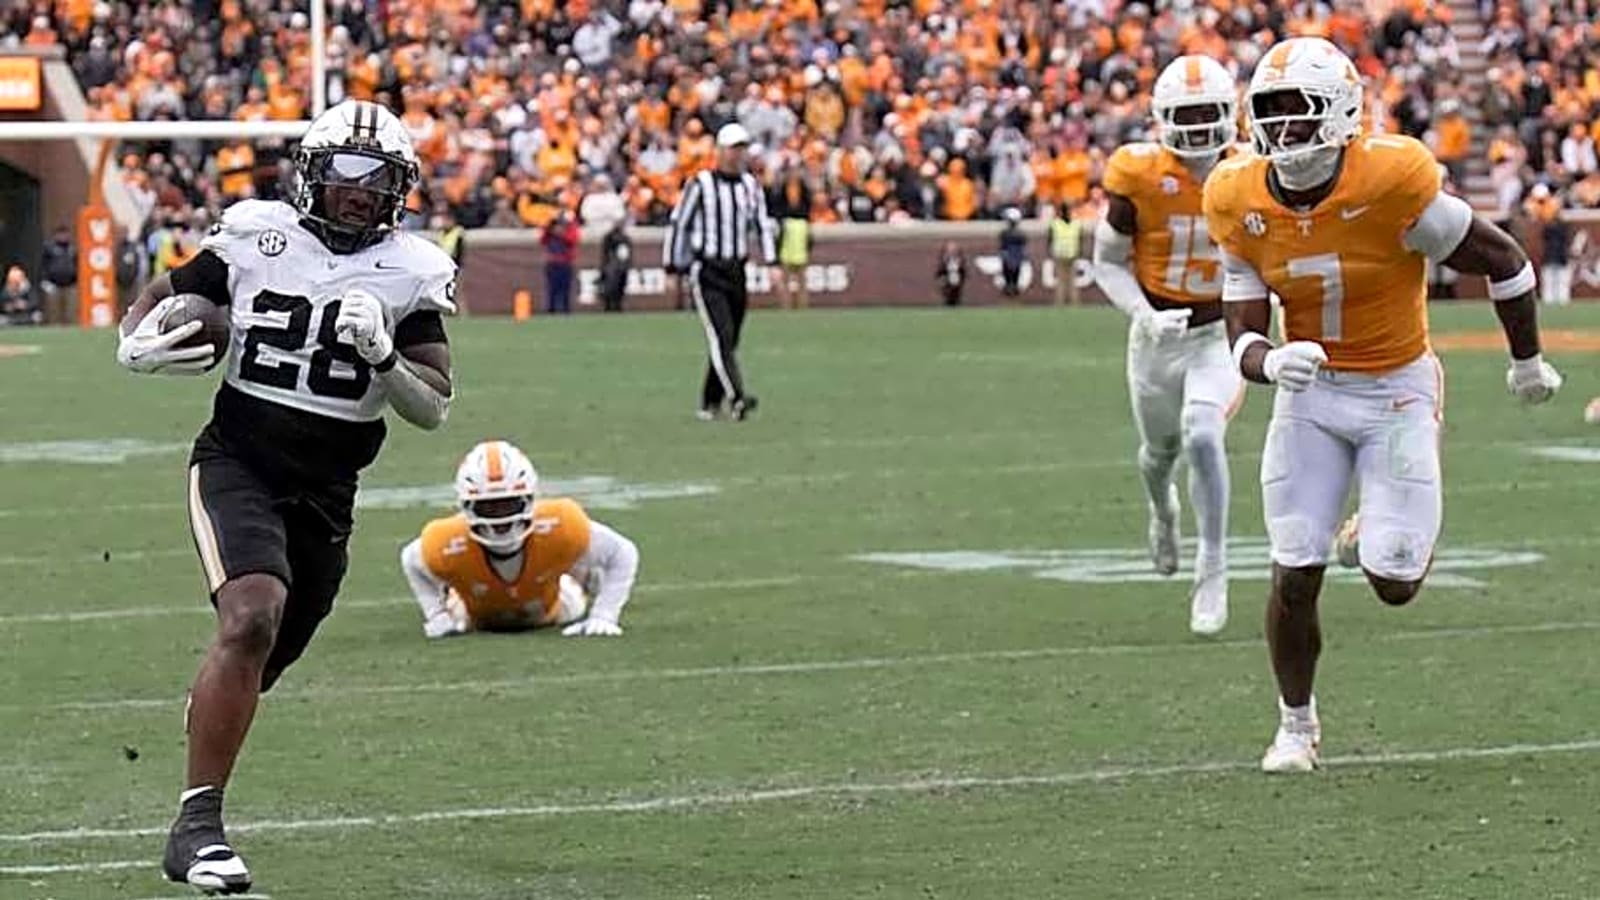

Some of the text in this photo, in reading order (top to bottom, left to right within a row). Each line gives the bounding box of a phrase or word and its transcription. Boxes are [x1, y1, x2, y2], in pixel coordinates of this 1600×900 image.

[88, 217, 113, 327] VOLS
[258, 229, 287, 256] SEC
[1166, 214, 1223, 296] 15
[1286, 253, 1342, 342] 7
[239, 289, 372, 401] 28
